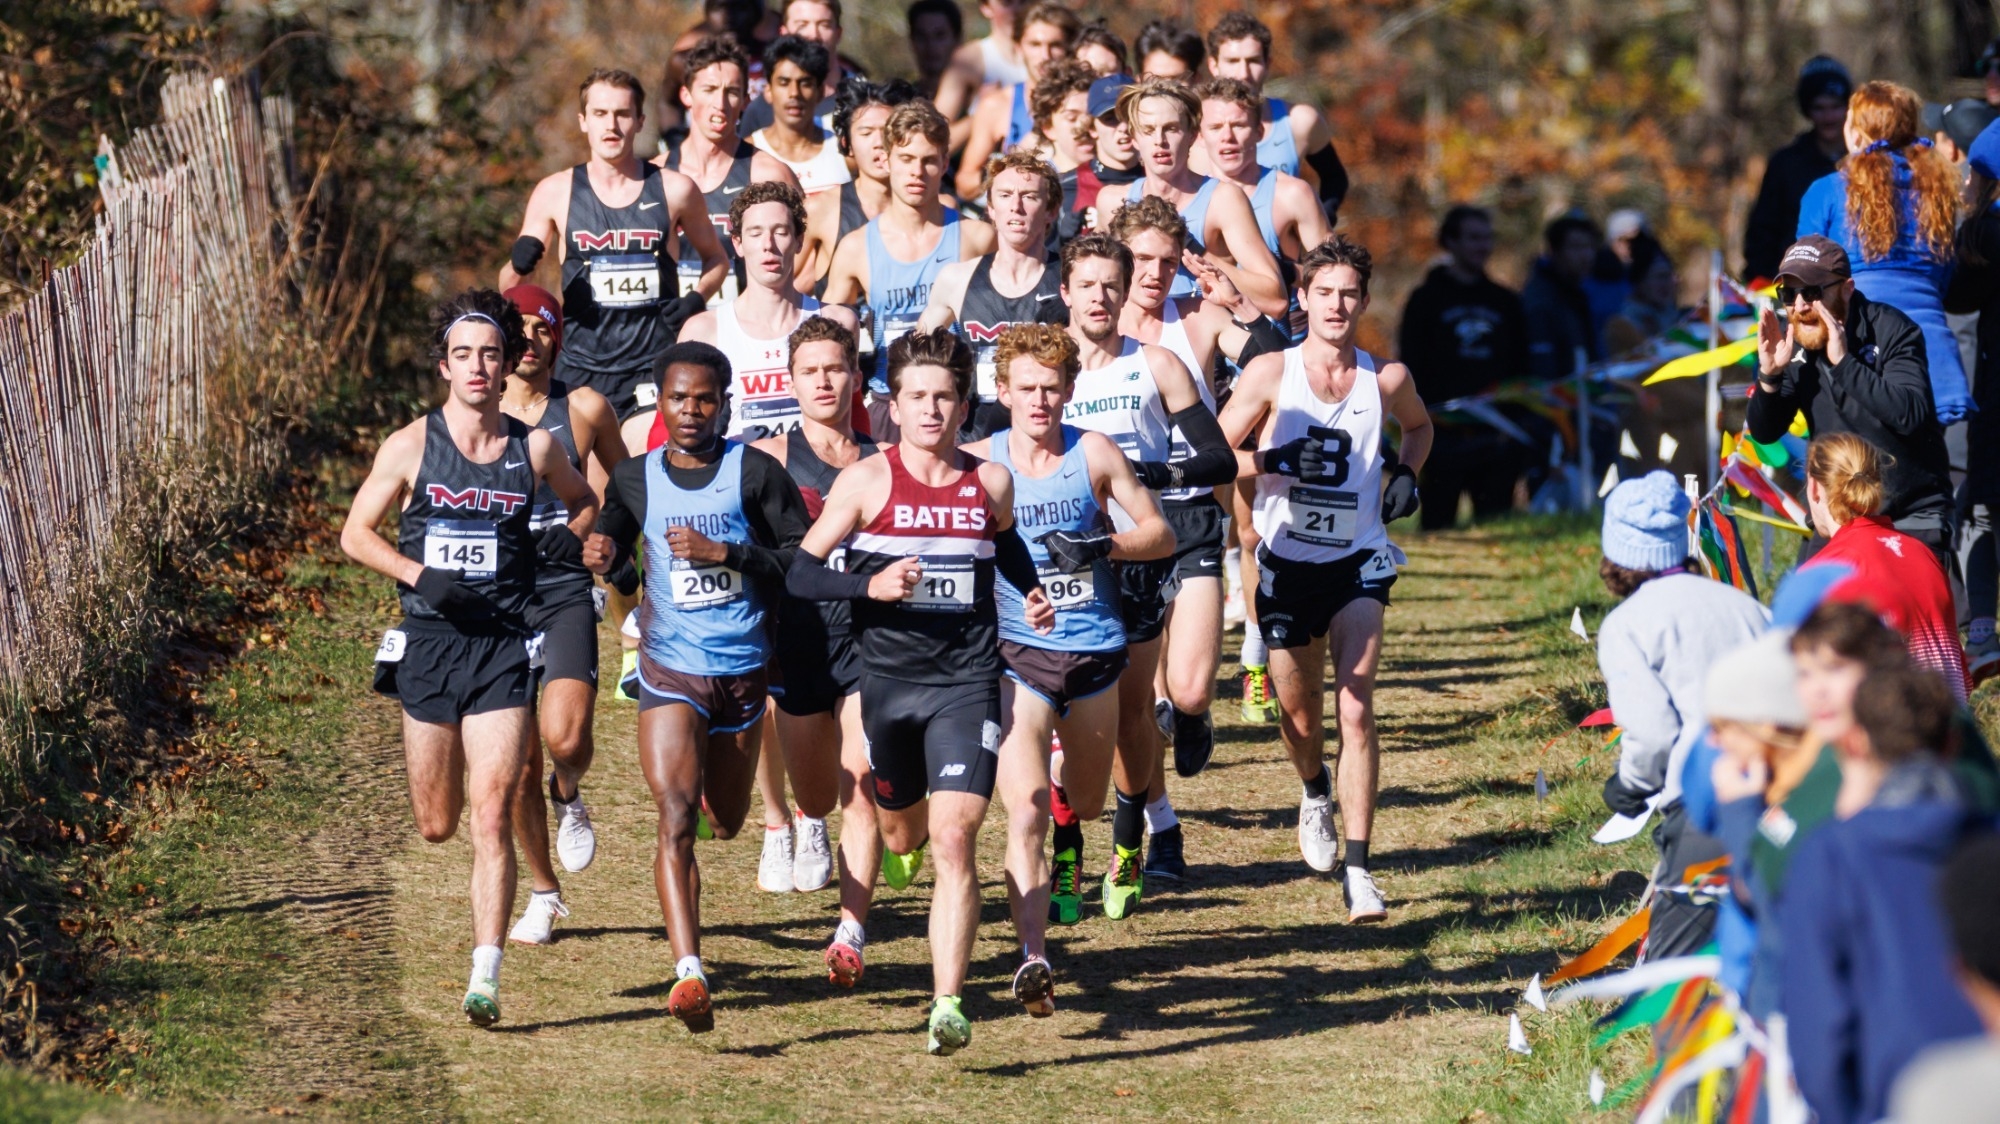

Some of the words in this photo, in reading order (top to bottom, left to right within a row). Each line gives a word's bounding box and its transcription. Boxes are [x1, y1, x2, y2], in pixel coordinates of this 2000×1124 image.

[572, 228, 663, 252] MIT
[603, 276, 649, 296] 144
[885, 282, 934, 311] JUMB
[539, 305, 556, 325] MIT
[1064, 395, 1141, 420] LYMOUTH
[1300, 424, 1353, 488] B
[426, 483, 527, 516] MIT
[893, 504, 987, 531] BATES
[1305, 510, 1336, 533] 21
[438, 544, 485, 565] 145
[1372, 552, 1393, 572] 21
[683, 571, 731, 596] 200
[924, 578, 956, 598] 10
